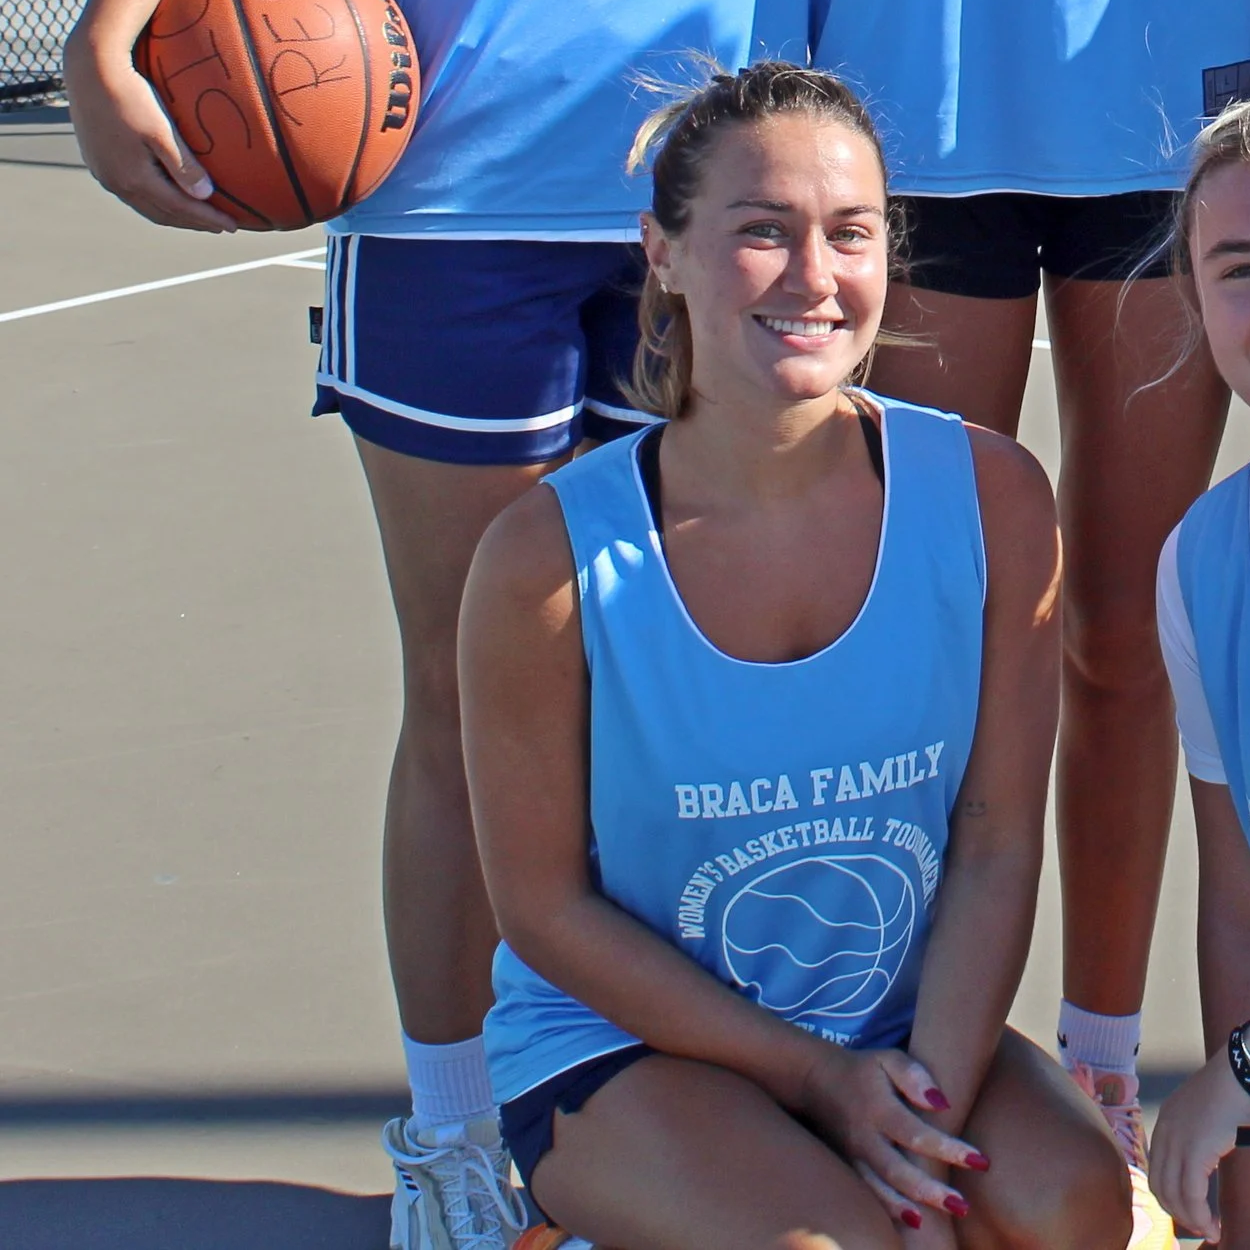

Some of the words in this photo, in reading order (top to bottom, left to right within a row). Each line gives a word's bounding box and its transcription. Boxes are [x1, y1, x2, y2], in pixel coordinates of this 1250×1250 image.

[675, 775, 799, 819] BRACA
[810, 741, 945, 806] FAMILY
[677, 861, 724, 940] WOMEN'S
[715, 816, 874, 876] BASKETBALL
